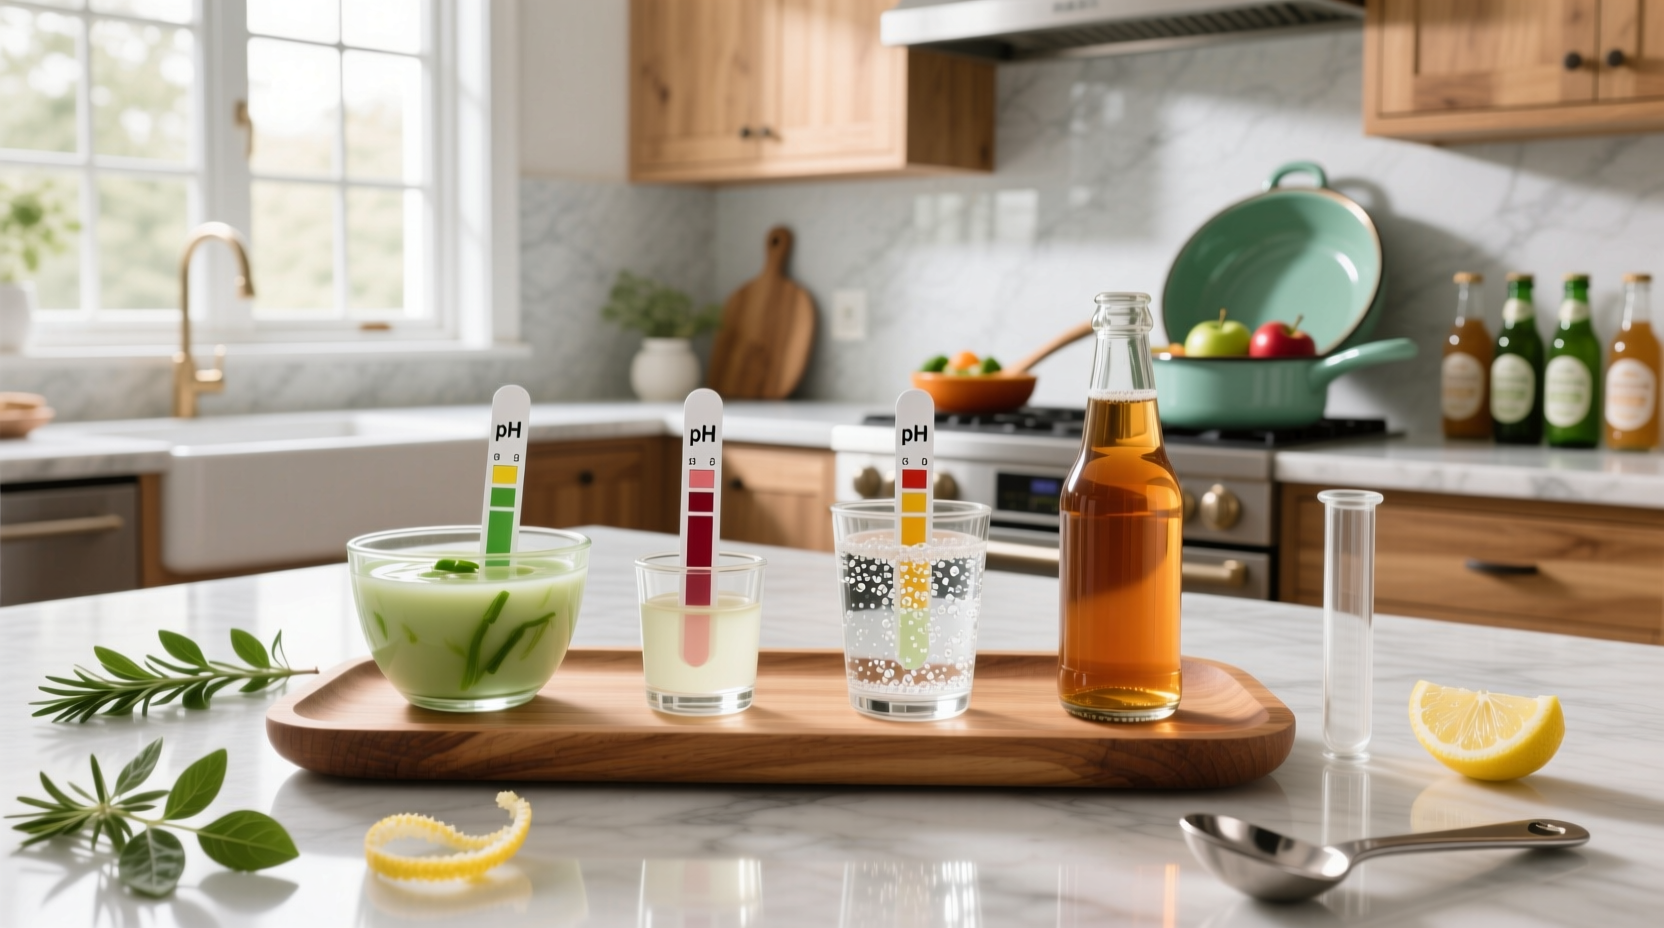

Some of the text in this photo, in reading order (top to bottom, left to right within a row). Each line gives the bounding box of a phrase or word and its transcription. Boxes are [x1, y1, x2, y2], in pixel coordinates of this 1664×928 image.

[495, 421, 521, 441] pH
[690, 425, 716, 446] pH
[902, 425, 928, 446] pH
